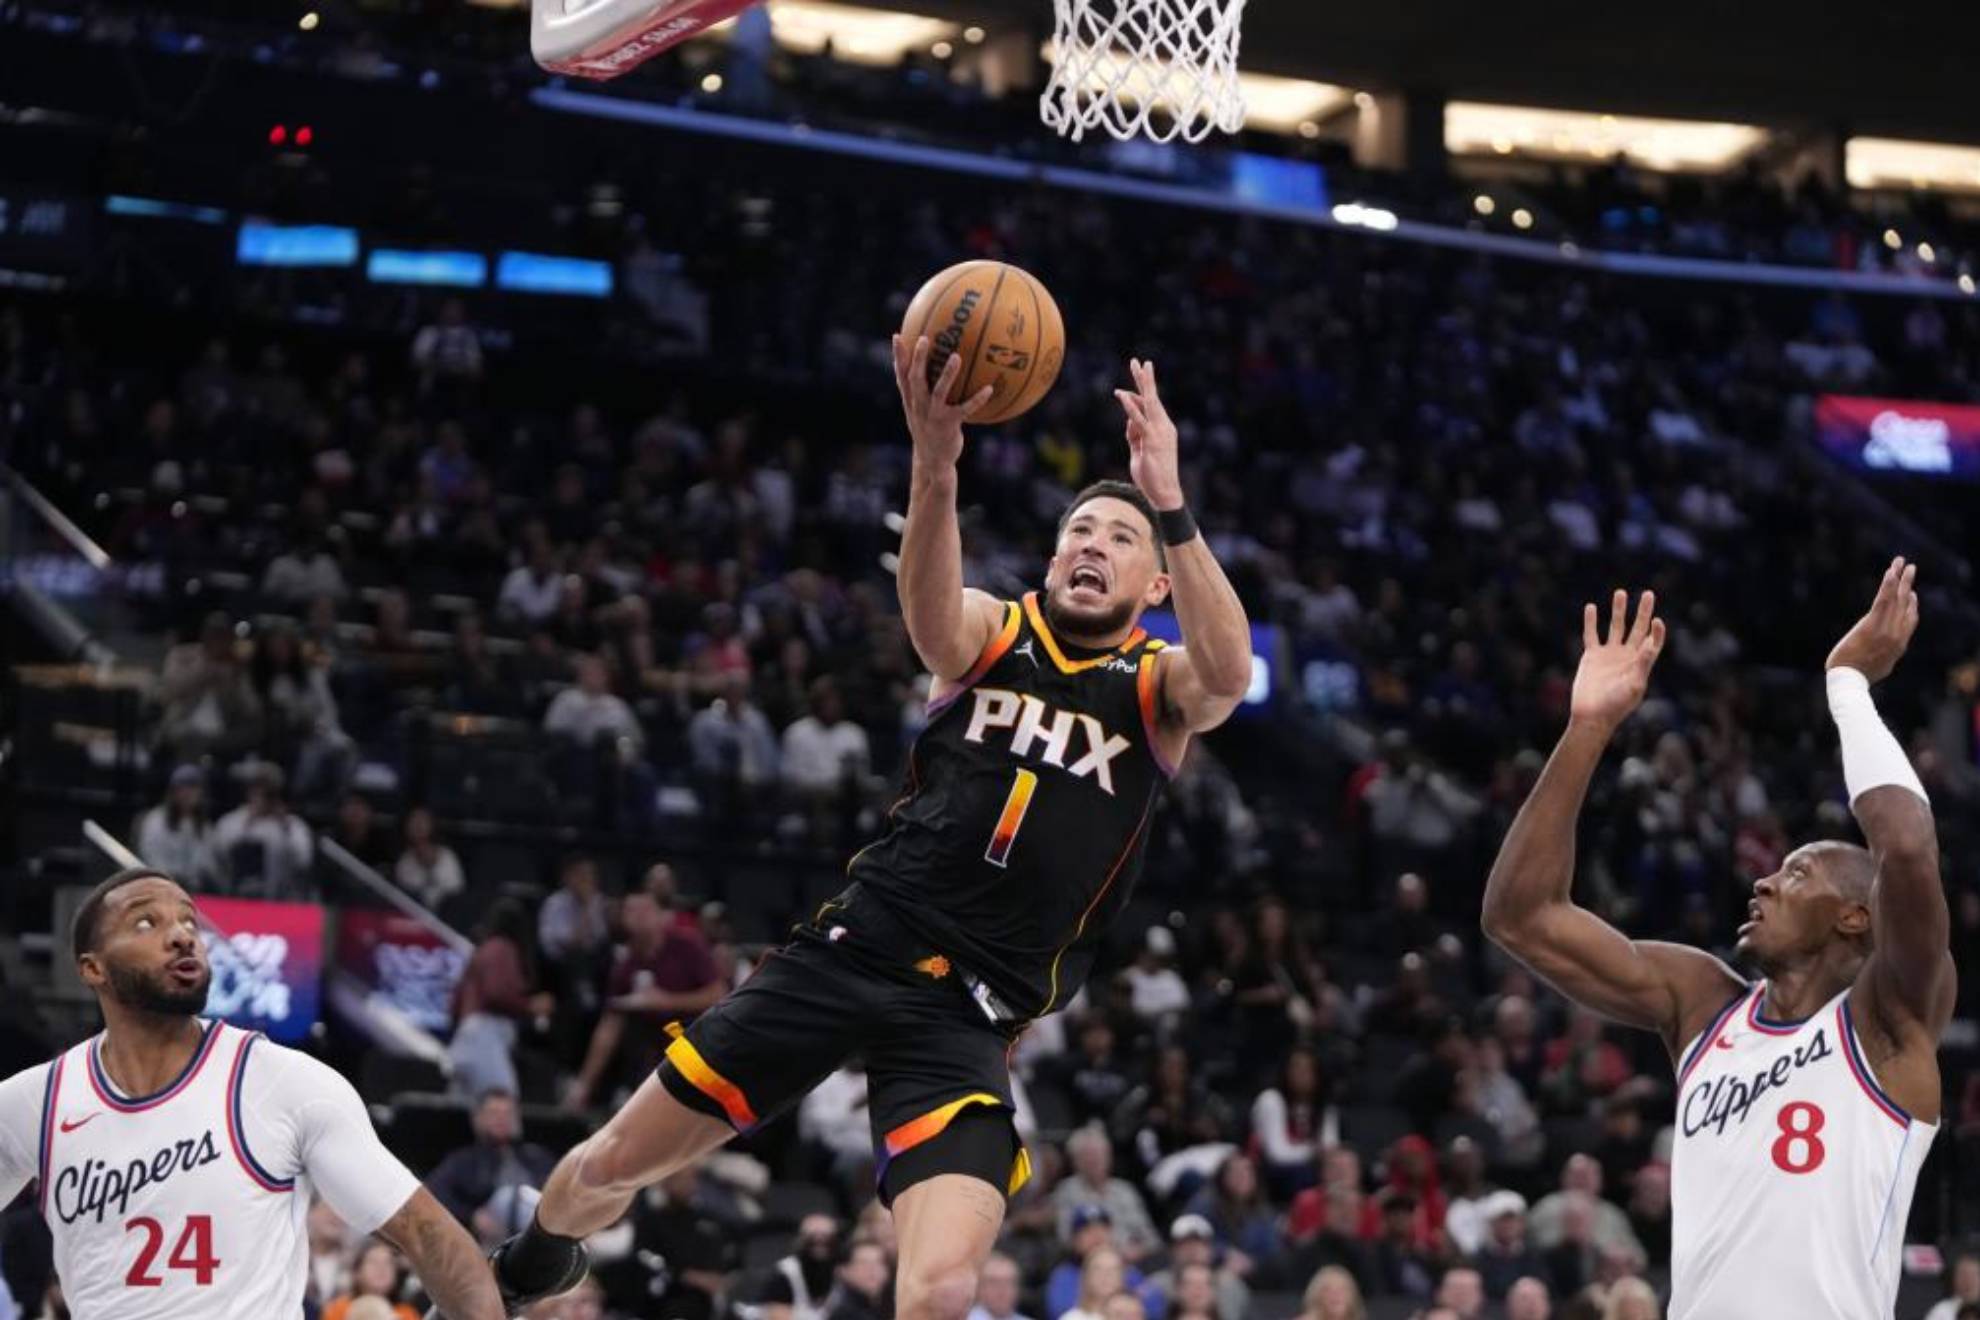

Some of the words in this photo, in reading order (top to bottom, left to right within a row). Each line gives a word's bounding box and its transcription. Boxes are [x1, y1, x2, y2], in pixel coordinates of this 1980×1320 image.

[1099, 658, 1137, 673] yPal
[964, 687, 1131, 796] PHX
[984, 767, 1038, 868] 1
[1683, 1028, 1832, 1137] Clippers
[55, 1130, 221, 1224] Clippers
[1771, 1101, 1825, 1174] 8
[125, 1215, 221, 1286] 24
